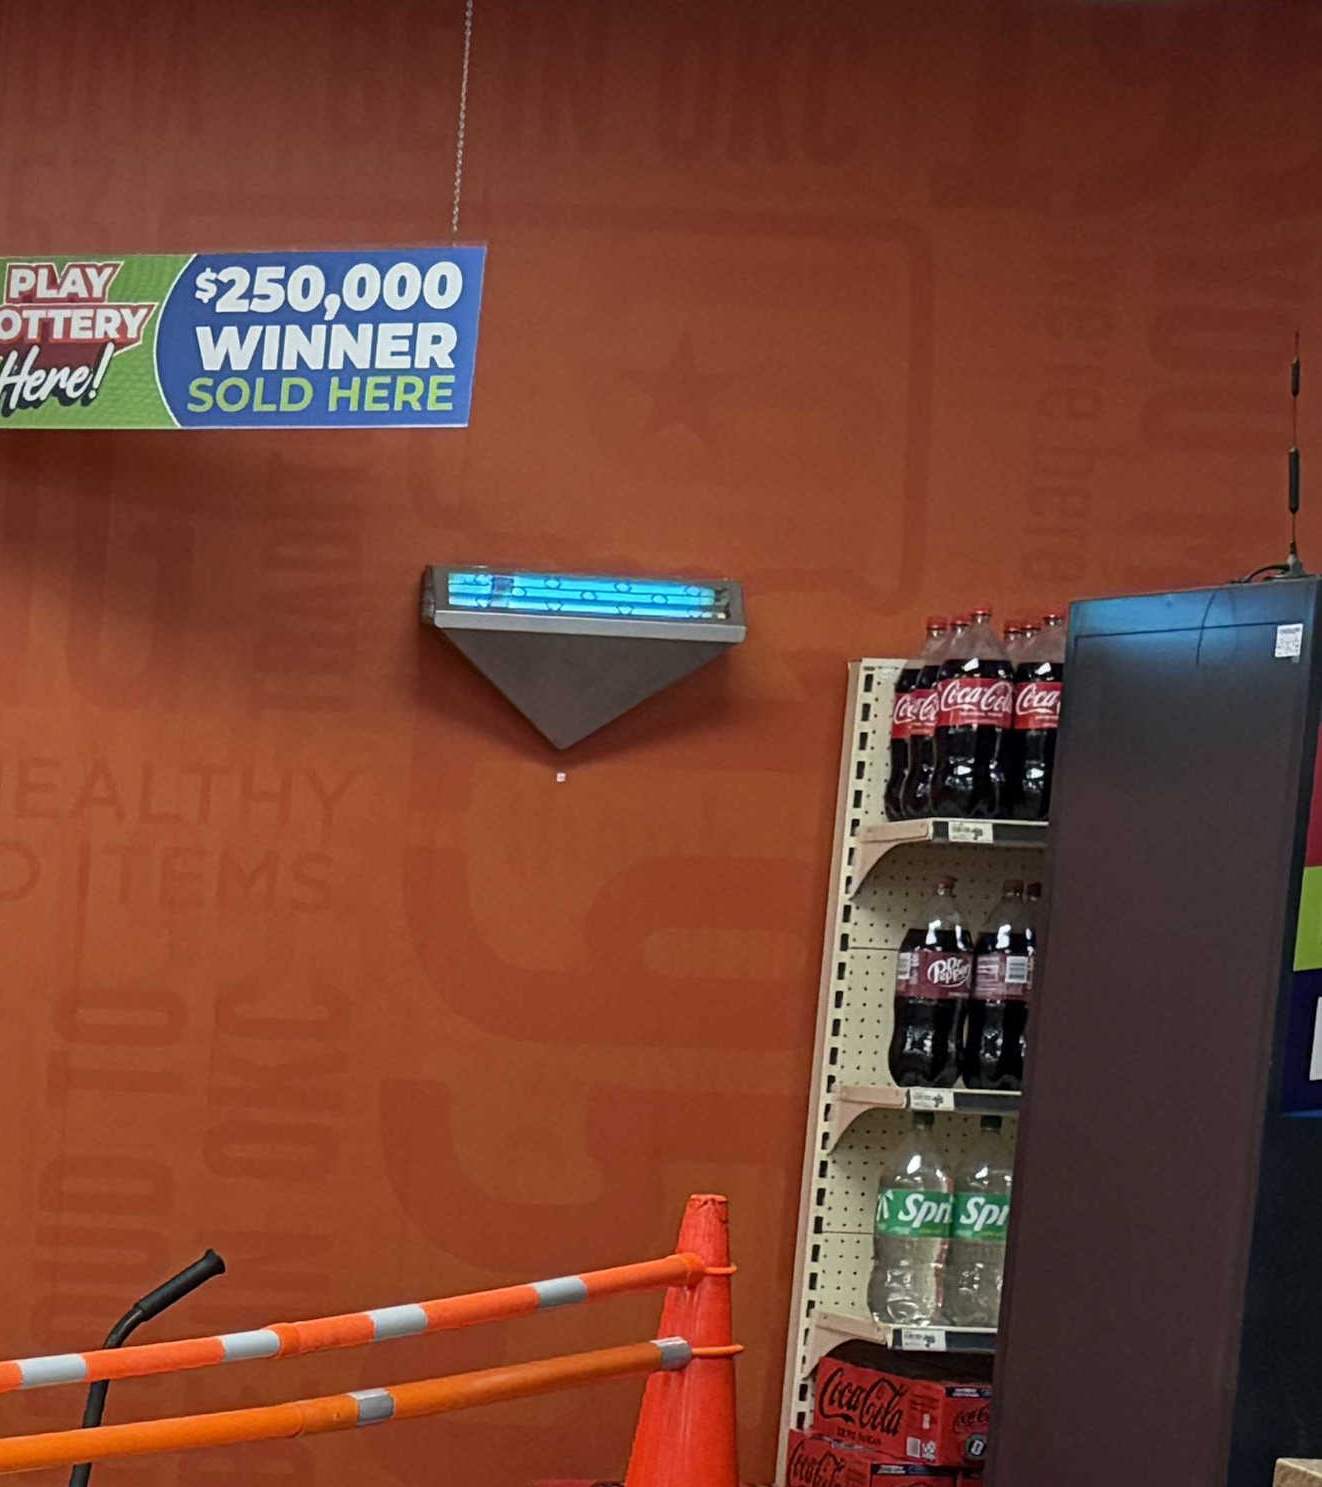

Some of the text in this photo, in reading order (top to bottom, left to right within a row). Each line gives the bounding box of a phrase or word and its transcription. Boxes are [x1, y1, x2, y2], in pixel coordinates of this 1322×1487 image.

[10, 265, 114, 299] PLAY
[194, 262, 463, 321] $250,000
[194, 322, 458, 372] WINNER
[186, 375, 455, 414] SOLD HERE
[77, 842, 338, 915] ITEMS
[927, 962, 972, 990] Pepper
